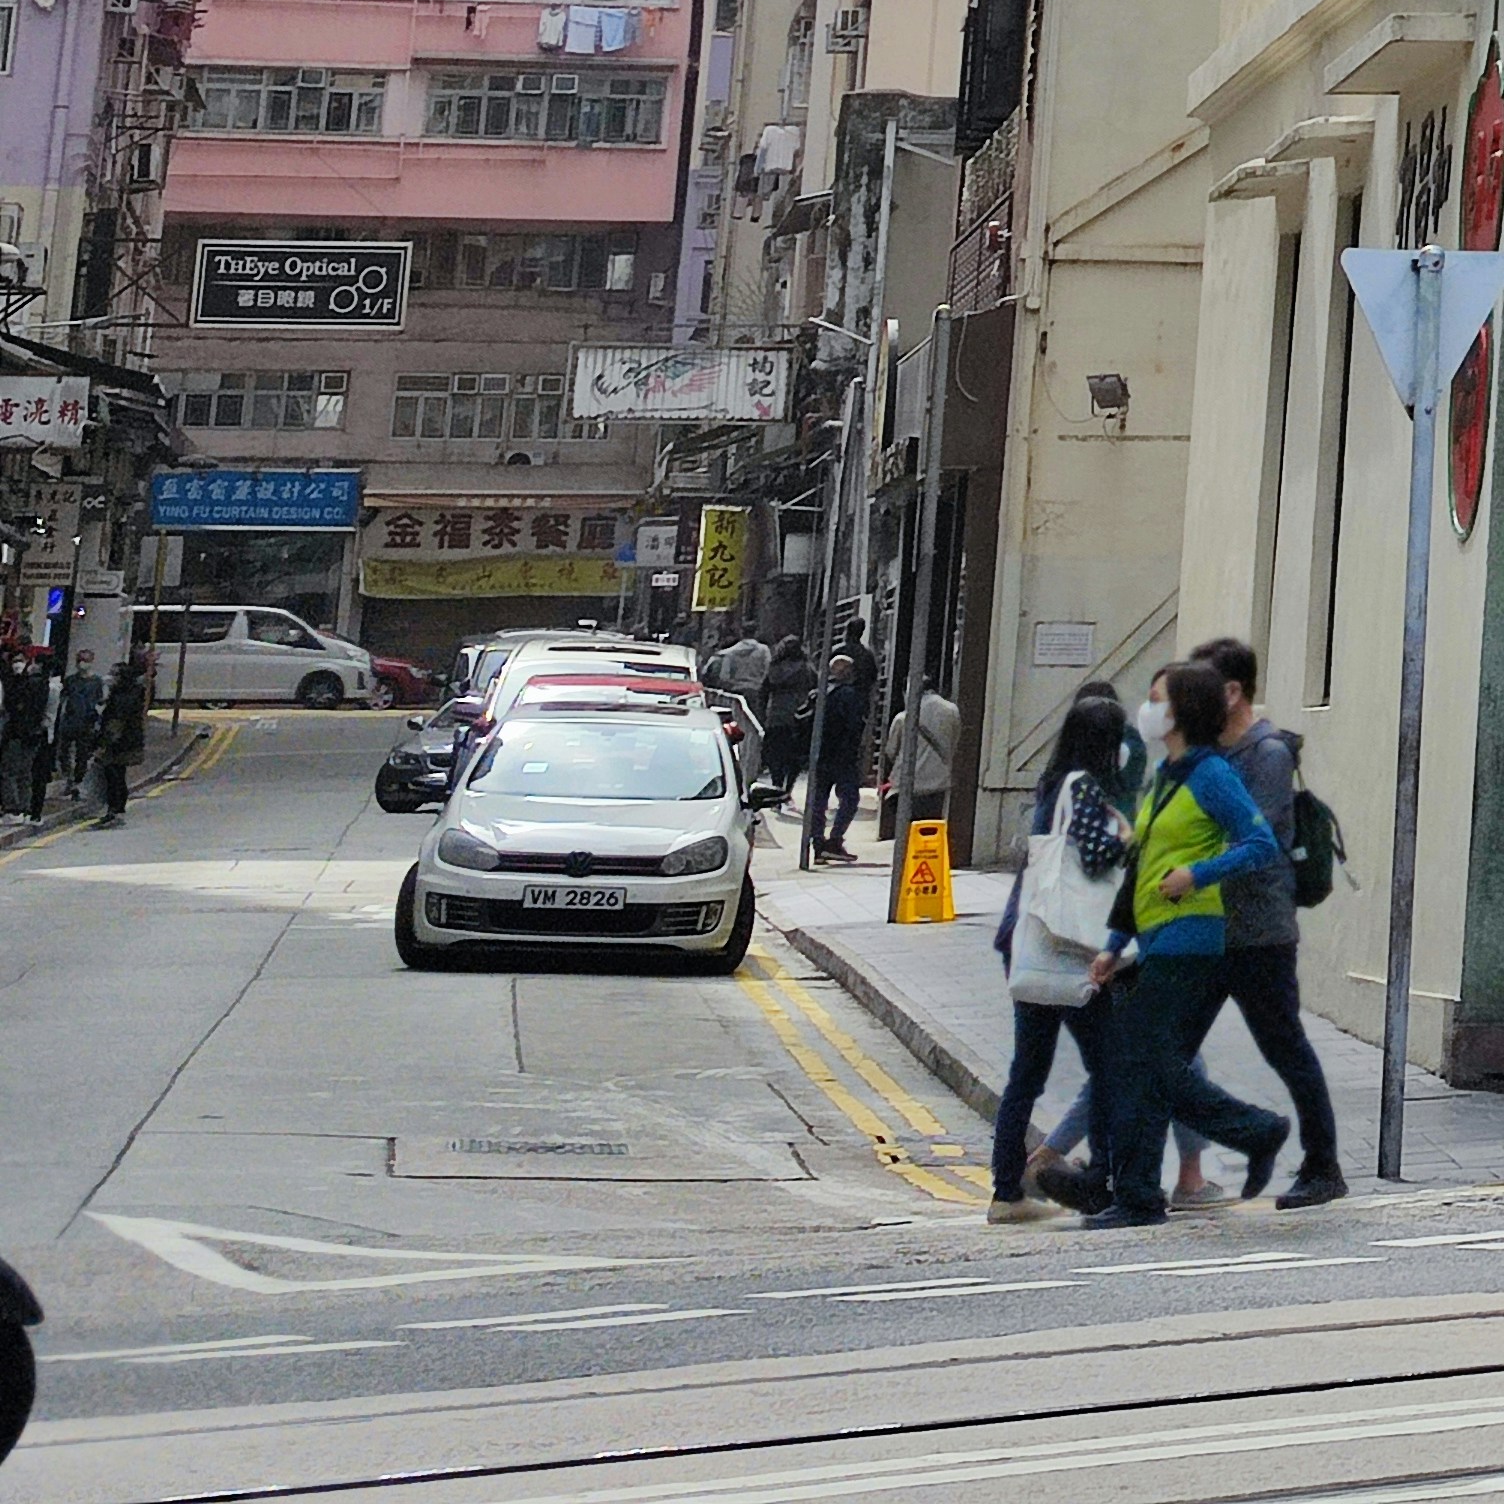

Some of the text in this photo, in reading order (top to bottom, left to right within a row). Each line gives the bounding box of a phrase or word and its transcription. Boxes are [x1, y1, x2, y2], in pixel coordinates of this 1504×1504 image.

[284, 256, 357, 280] Optical
[361, 298, 394, 317] 1/F
[158, 505, 189, 518] YING
[192, 505, 209, 518] FU
[212, 506, 269, 519] CURTAIN
[272, 506, 321, 519] DESIGN
[529, 889, 619, 907] VM 2826
